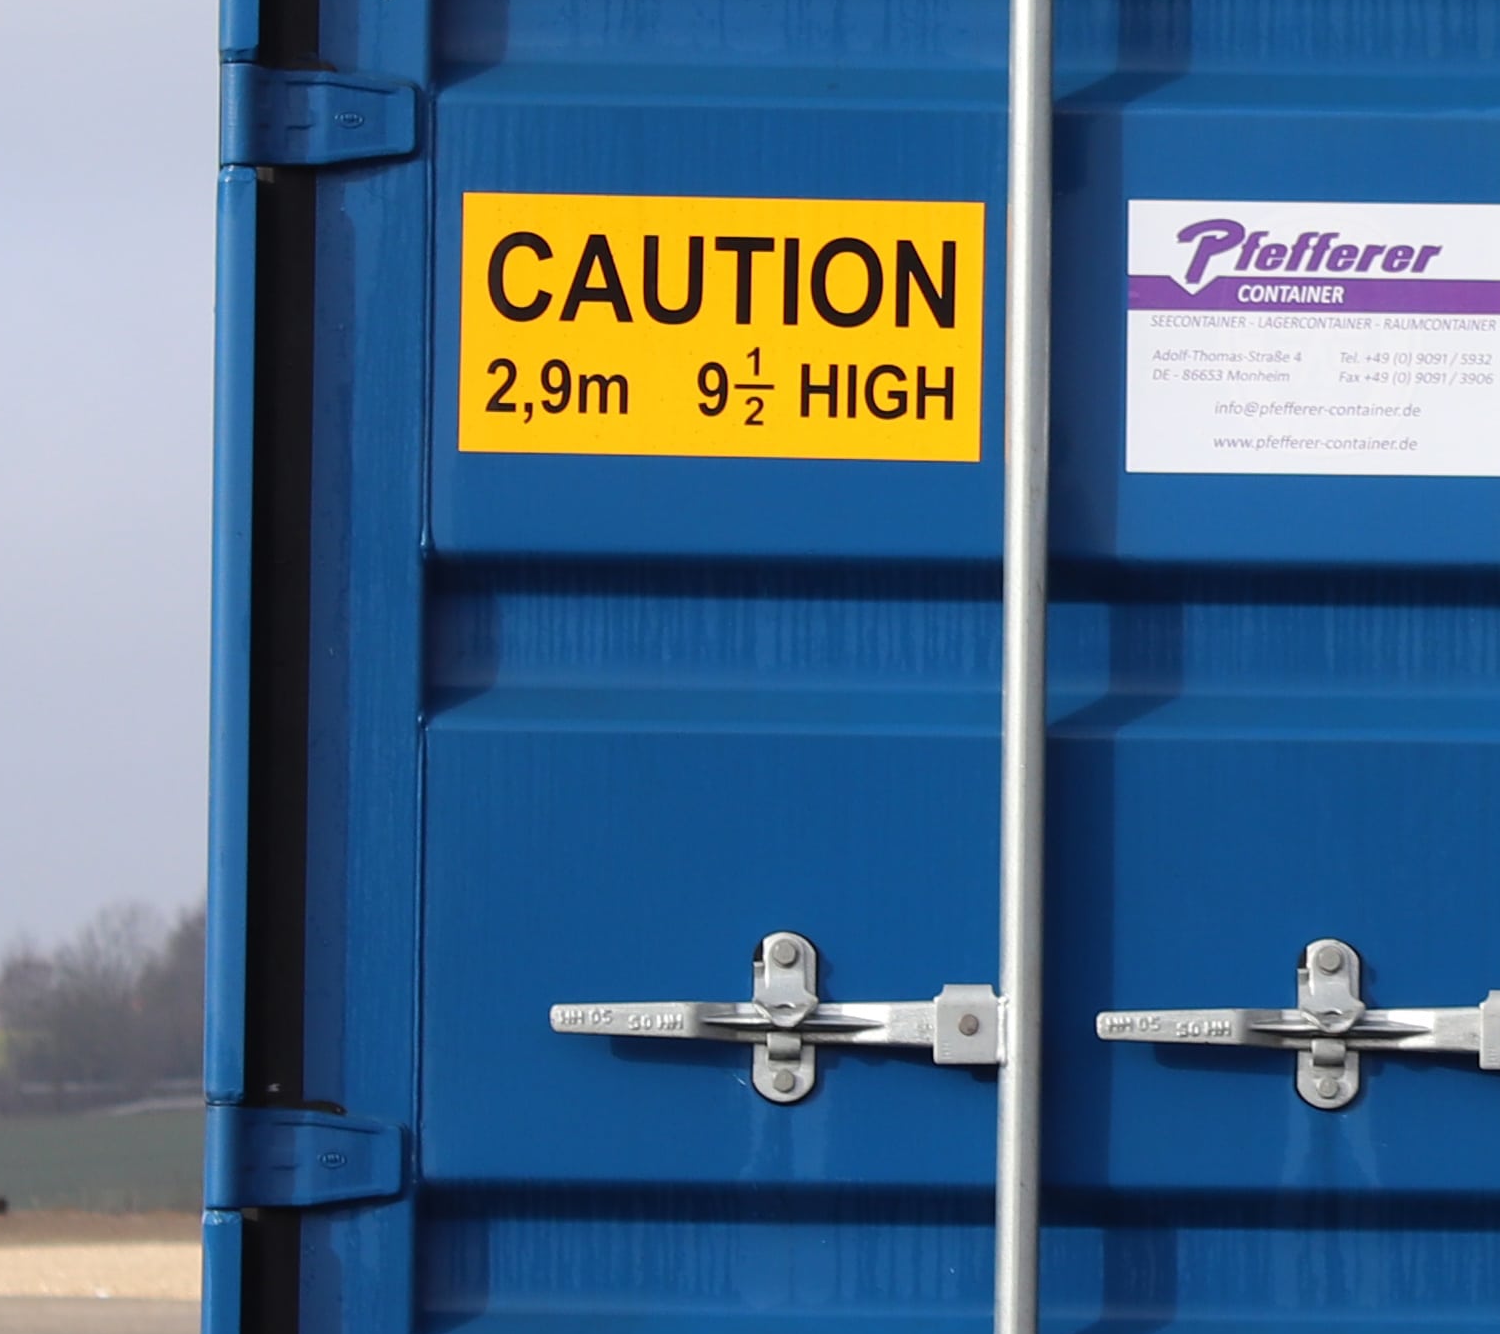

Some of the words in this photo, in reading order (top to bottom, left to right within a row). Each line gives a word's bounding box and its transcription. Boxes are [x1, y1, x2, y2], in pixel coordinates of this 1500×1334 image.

[1176, 218, 1444, 285] Pfefferer
[487, 231, 957, 329] CAUTION
[1237, 284, 1345, 304] CONTAINER
[1150, 314, 1246, 329] SEECONTAINER
[1258, 316, 1372, 330] LAGERCONTAINER
[1383, 318, 1496, 332] RAUMCONTAINER
[1152, 350, 1290, 363] Adolf-Thomas-Straße
[1293, 351, 1302, 363] 4
[1340, 352, 1360, 364] Tel.
[1365, 352, 1389, 365] +49
[1393, 352, 1412, 367] (0)
[1415, 352, 1447, 365] 9091
[1460, 353, 1493, 365] 5932
[1152, 369, 1170, 381] DE
[1182, 369, 1223, 382] 86653
[1226, 370, 1290, 383] Monheim
[1339, 371, 1361, 384] Fax
[1364, 372, 1389, 385] +49
[1392, 371, 1411, 386] (0)
[1415, 372, 1447, 385] 9091
[1459, 373, 1494, 385] 3906
[485, 357, 629, 424] 2,9m
[800, 363, 954, 421] HIGH
[1214, 401, 1421, 419] info@pfefferer-container.de
[1213, 435, 1418, 452] www.pfefferer-container.de
